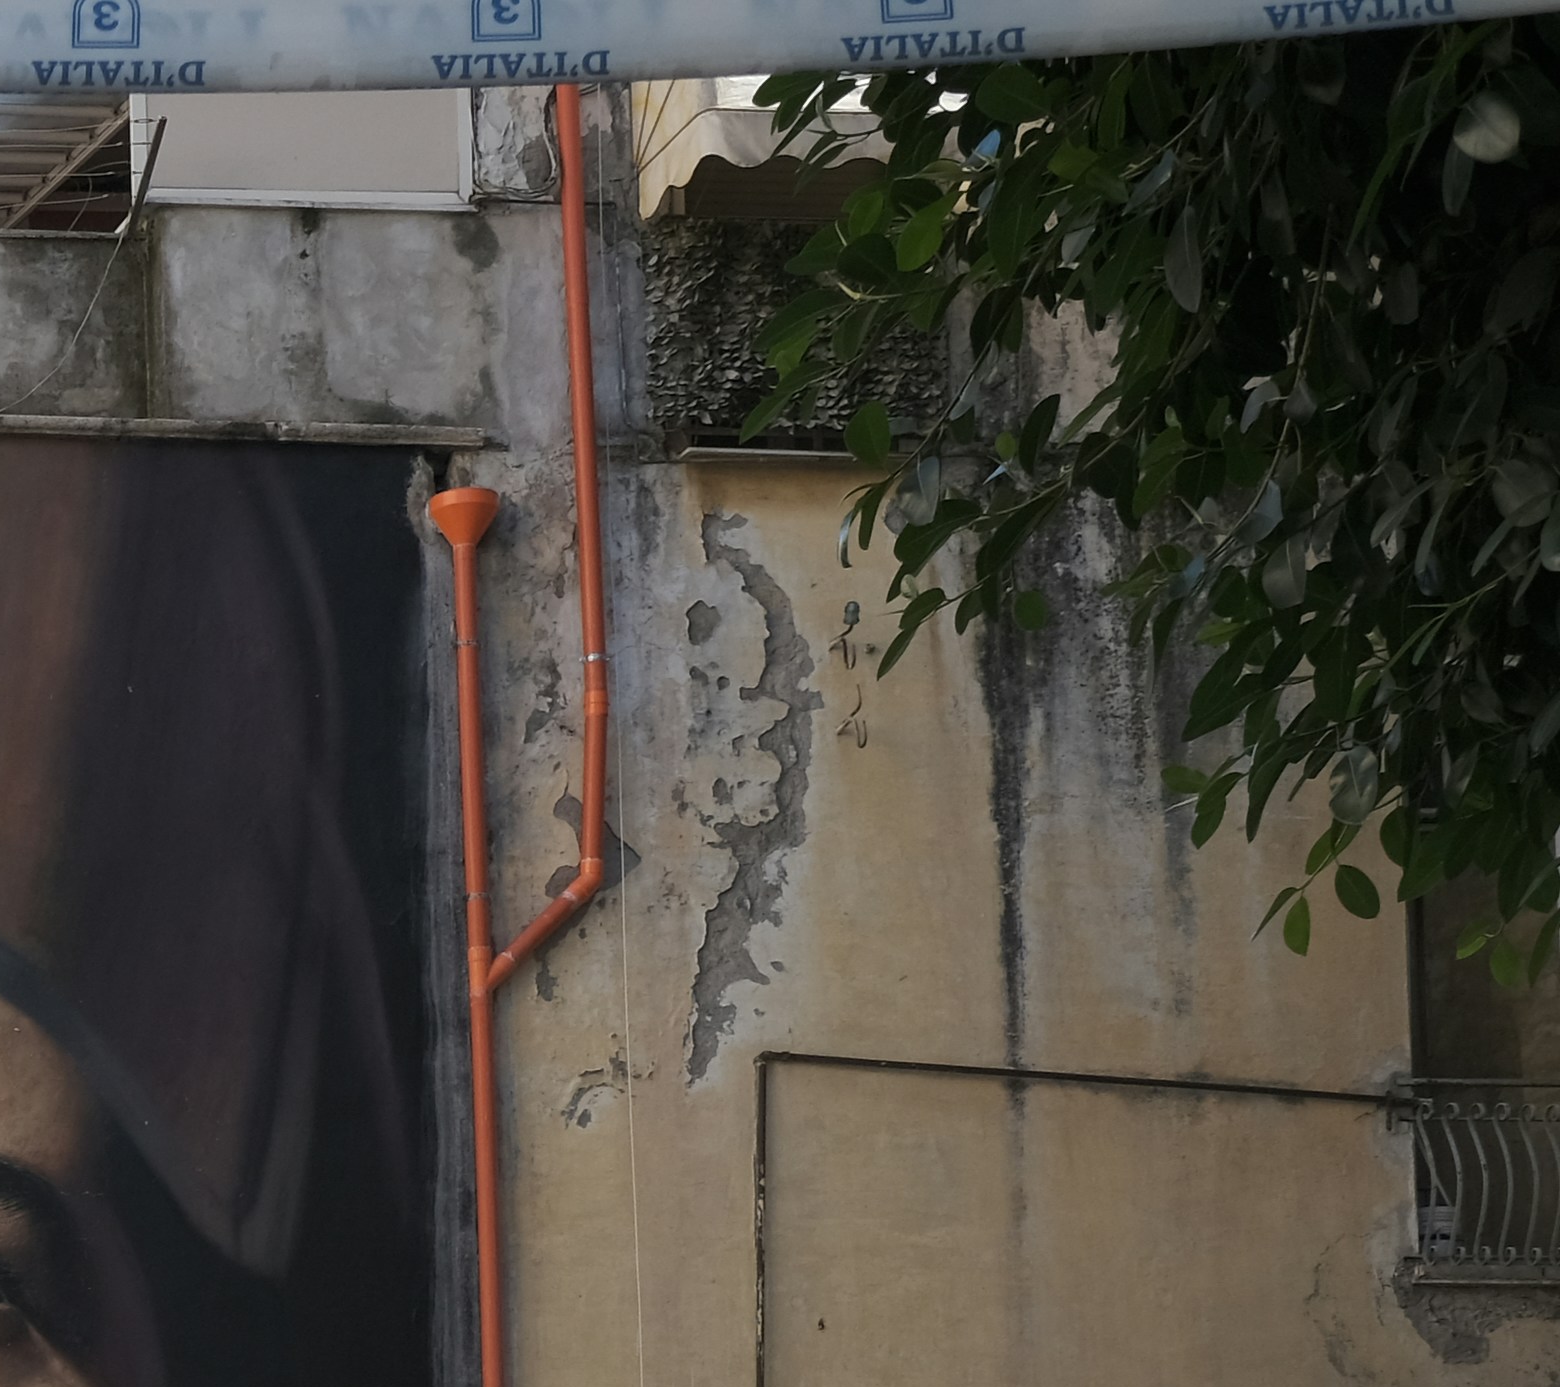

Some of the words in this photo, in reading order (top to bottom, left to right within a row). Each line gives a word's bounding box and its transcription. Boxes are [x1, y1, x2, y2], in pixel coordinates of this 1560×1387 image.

[842, 27, 1026, 62] D'ITALIA
[32, 60, 207, 87] D'ITALIA
[431, 50, 611, 80] D'ITALIA
